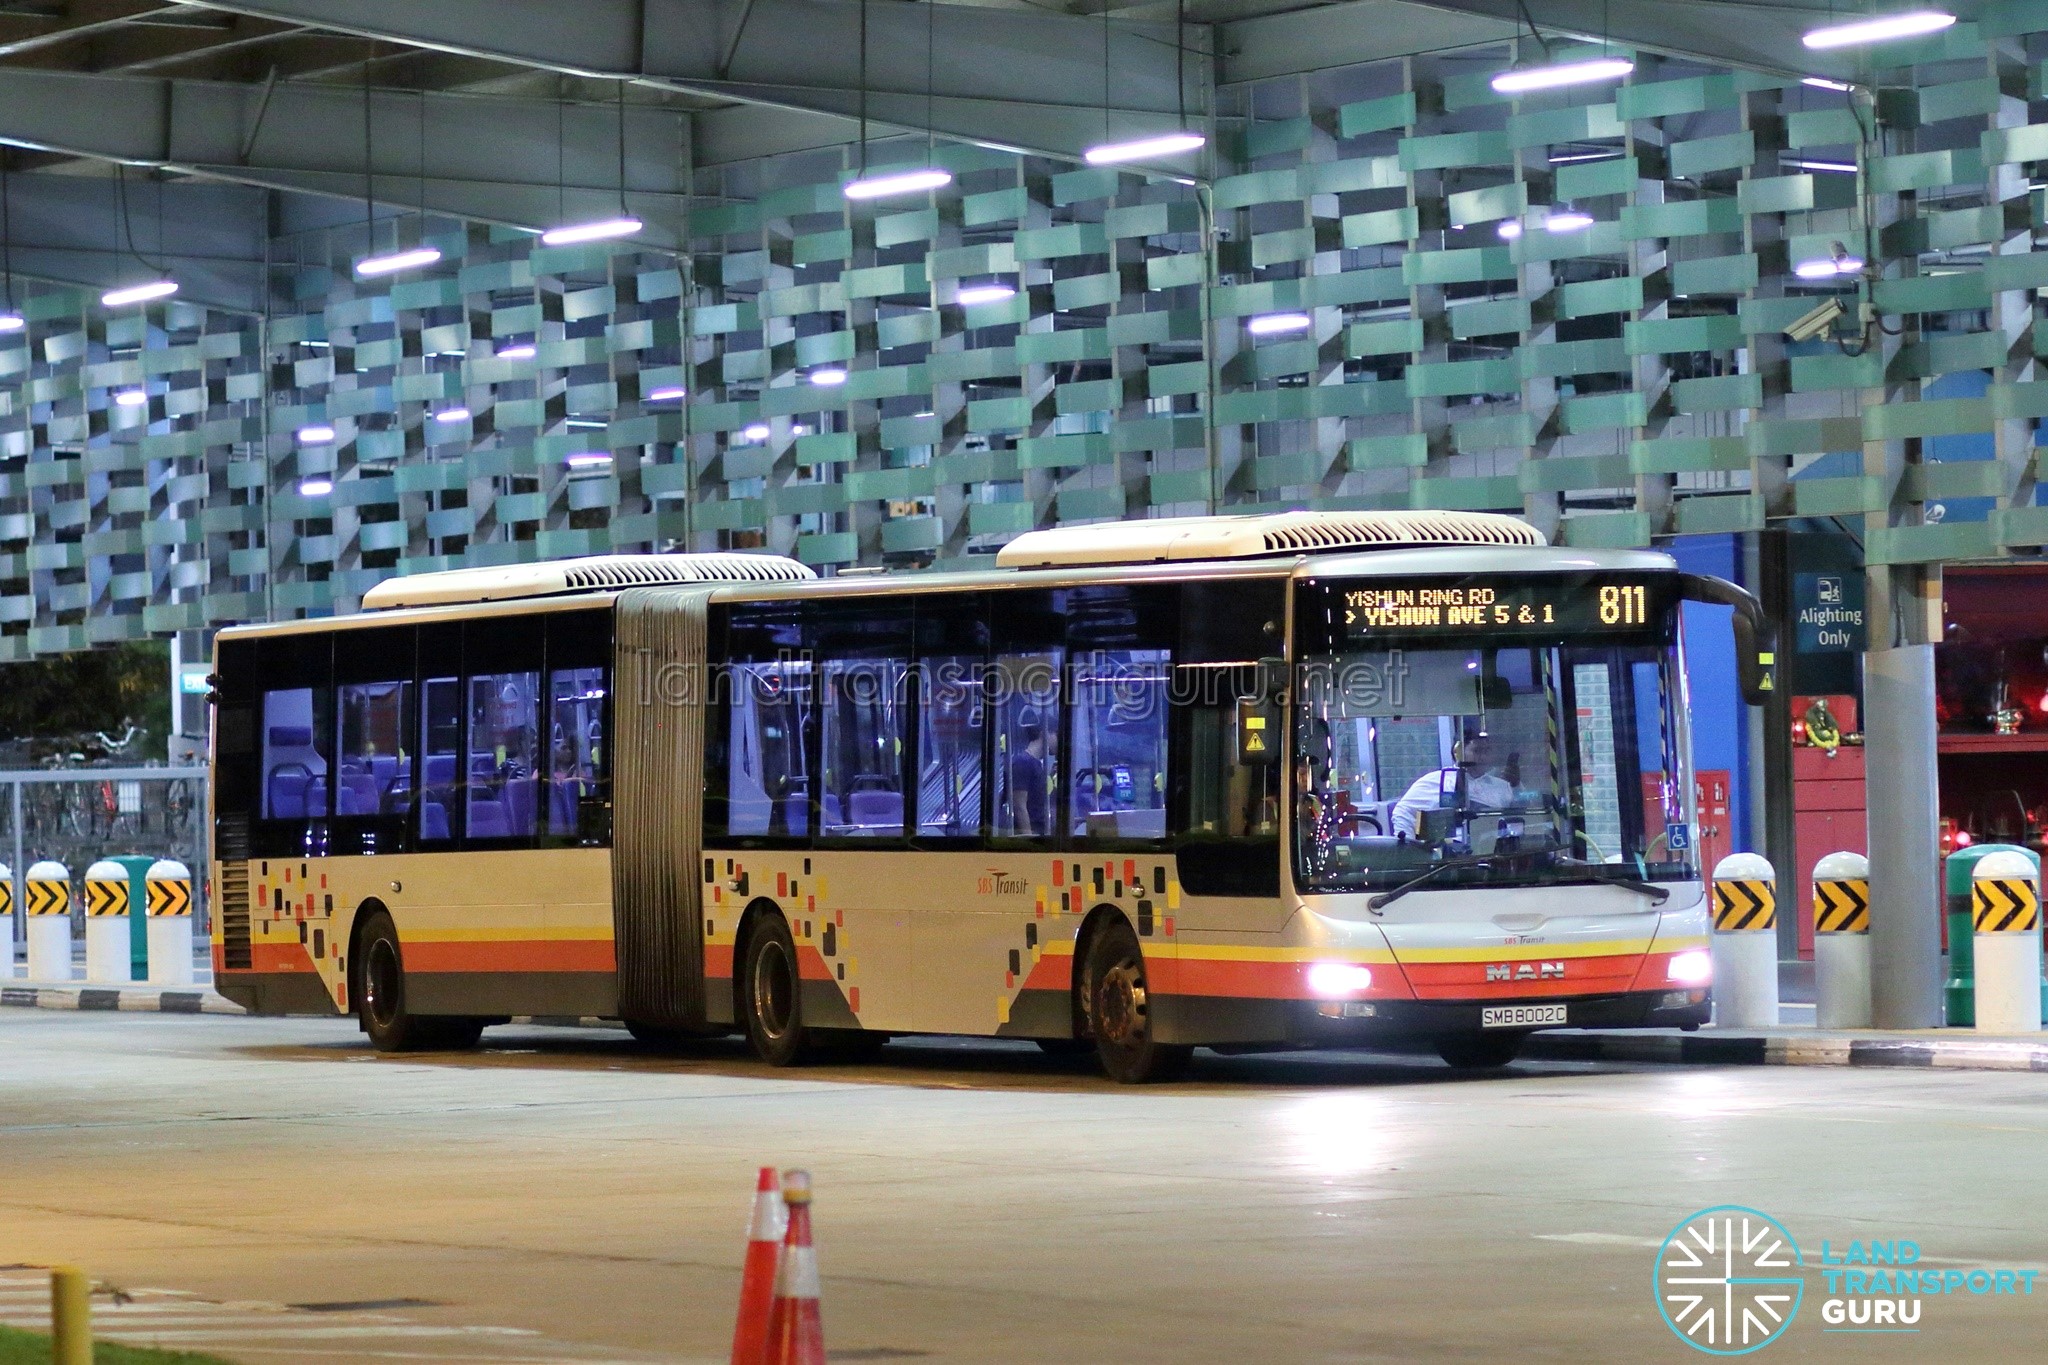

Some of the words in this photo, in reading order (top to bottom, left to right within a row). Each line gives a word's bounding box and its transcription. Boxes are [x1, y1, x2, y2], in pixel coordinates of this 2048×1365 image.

[1345, 590, 1414, 607] YISHUN
[1419, 588, 1463, 606] RING
[1469, 588, 1495, 605] RD
[1600, 586, 1645, 623] 811
[1365, 606, 1440, 626] YISHUN
[1448, 605, 1487, 626] AVE
[1495, 605, 1510, 624] 5
[1518, 604, 1535, 623] &
[1543, 604, 1555, 623] 1
[1800, 607, 1862, 626] Alighting
[1819, 629, 1850, 648] Only
[977, 877, 993, 895] SBS
[991, 872, 1029, 896] Transit
[1504, 937, 1517, 945] SBS
[1519, 935, 1545, 945] Transit
[1486, 962, 1565, 982] MAN
[1484, 1006, 1565, 1025] SMB8002C
